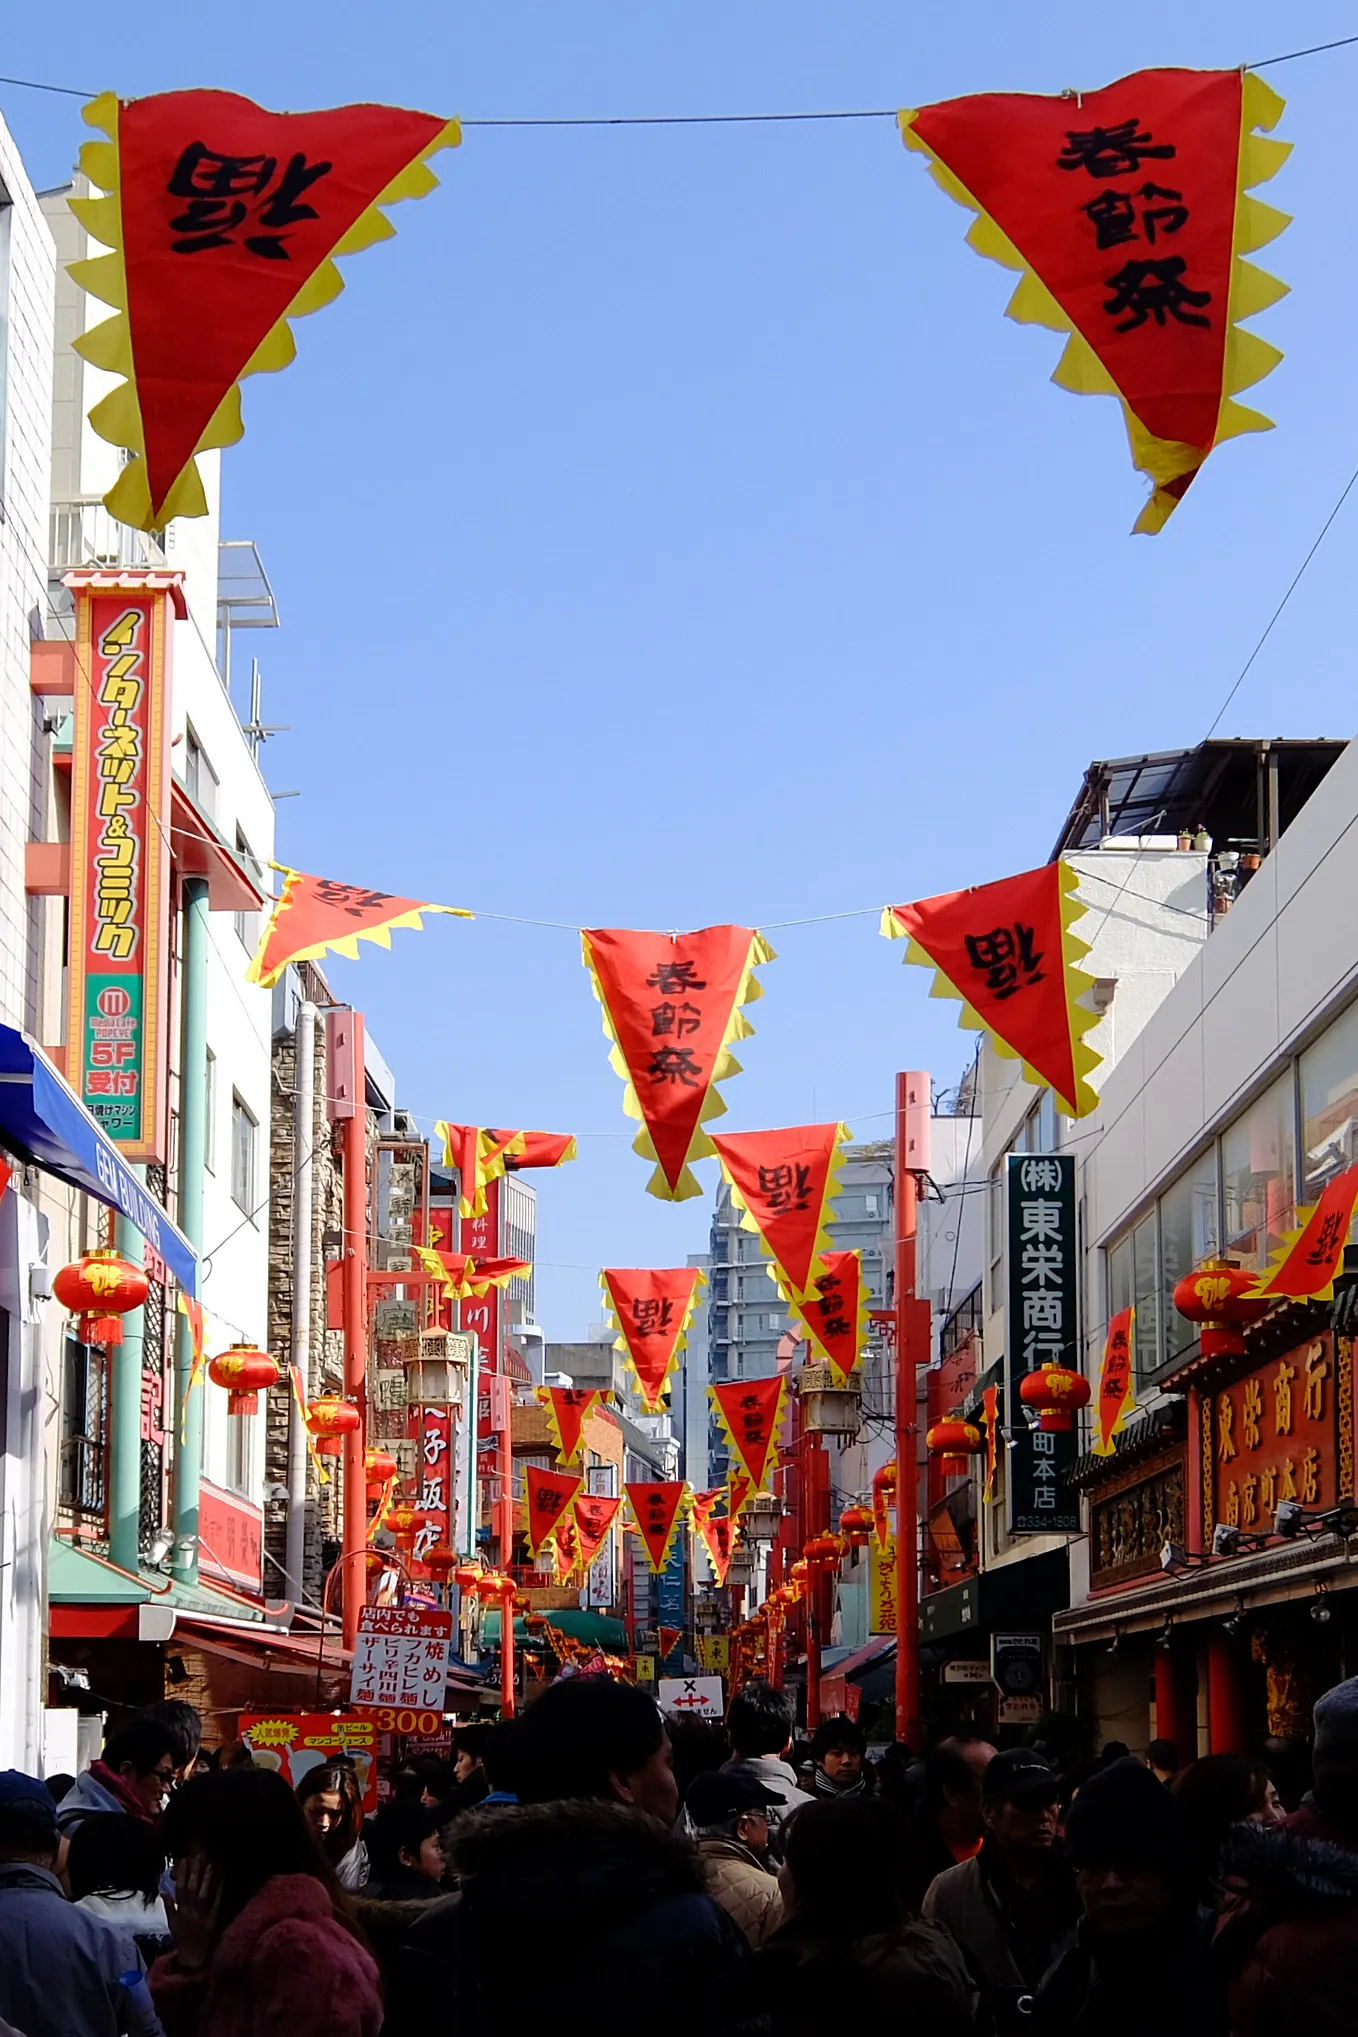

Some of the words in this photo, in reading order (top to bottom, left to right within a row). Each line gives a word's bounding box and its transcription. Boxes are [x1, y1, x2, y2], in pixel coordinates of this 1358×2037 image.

[166, 142, 333, 260] 福
[1056, 118, 1212, 333] 春節祭
[965, 921, 1048, 1000] 福
[91, 1042, 136, 1065] 5F
[96, 1028, 130, 1038] POPEYE
[646, 960, 707, 1087] 春節祭
[87, 1070, 139, 1095] 受付
[97, 1117, 133, 1130] ャワー
[1032, 1407, 1056, 1509] 町本店
[360, 1620, 448, 1637] 食べられます
[361, 1607, 420, 1622] 店内でも
[357, 1637, 380, 1702] ザーサイ麺
[400, 1639, 422, 1705] フカヒレ麺
[423, 1641, 445, 1707] 焼めし
